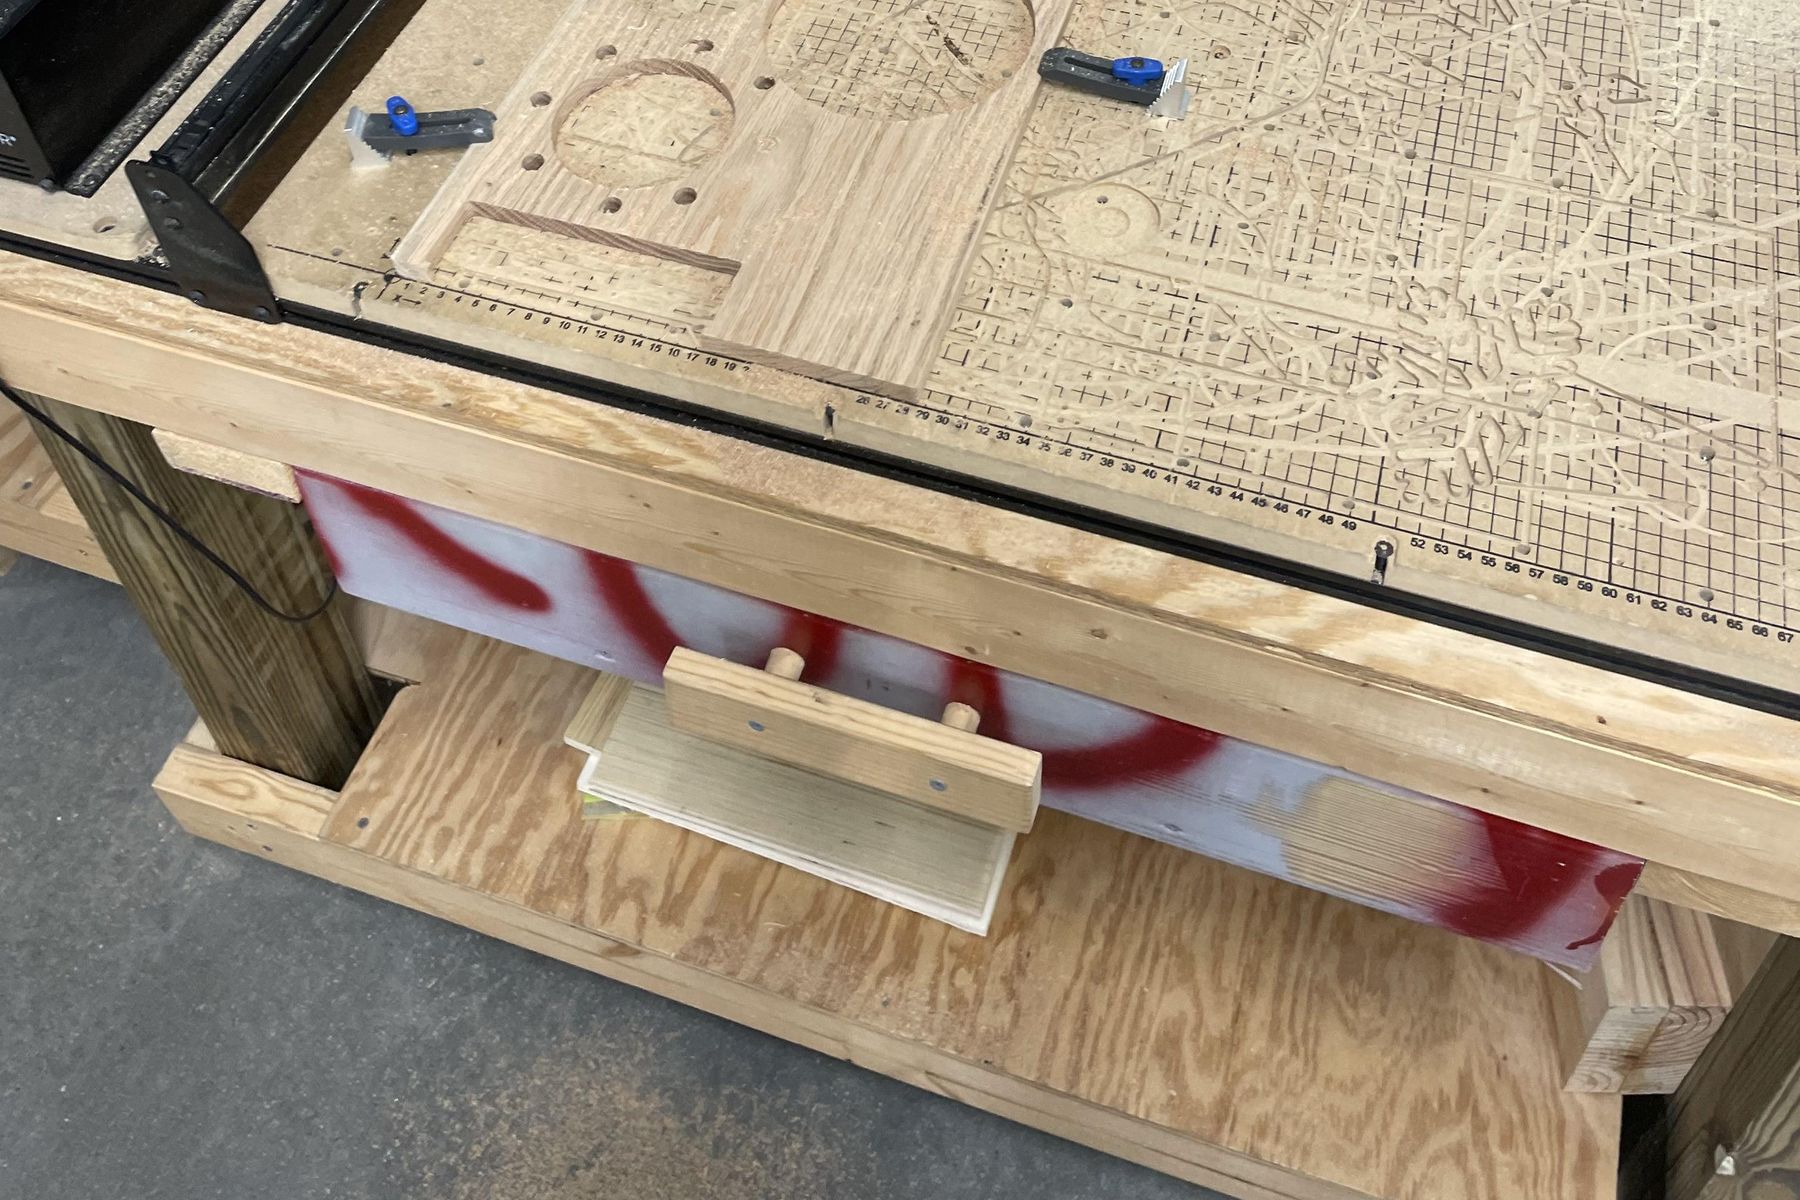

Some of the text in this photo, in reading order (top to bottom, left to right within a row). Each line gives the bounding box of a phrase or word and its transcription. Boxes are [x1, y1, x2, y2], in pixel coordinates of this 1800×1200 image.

[419, 286, 428, 295] 2
[436, 291, 445, 299] 3
[489, 303, 498, 312] 6
[507, 308, 516, 316] 7
[524, 312, 532, 321] 8
[542, 316, 551, 325] 9
[559, 320, 571, 330] 10
[577, 325, 588, 335] 11
[595, 329, 607, 339] 12
[613, 334, 626, 344] 13
[631, 338, 643, 348] 14
[649, 343, 662, 353] 15
[686, 352, 700, 362] 17
[705, 356, 718, 367] 18
[724, 361, 737, 371] 19
[935, 414, 950, 425] 30
[975, 424, 990, 436] 32
[995, 430, 1010, 441] 33
[1016, 435, 1030, 446] 34
[1079, 451, 1094, 462] 37
[1100, 456, 1115, 468] 38
[1121, 462, 1136, 473] 39
[1142, 468, 1157, 479] 40
[1163, 473, 1178, 485] 41
[1185, 479, 1200, 490] 42
[1206, 485, 1222, 496] 43
[1229, 491, 1244, 502] 44
[1251, 496, 1267, 508] 45
[1273, 502, 1289, 514] 46
[1295, 508, 1312, 519] 47
[1318, 514, 1334, 525] 48
[1341, 519, 1357, 531] 49
[1410, 537, 1426, 549] 52
[1433, 543, 1449, 555] 53
[1457, 549, 1472, 561] 54
[1481, 555, 1497, 568] 55
[1504, 561, 1520, 573] 56
[1528, 567, 1545, 579] 57
[1552, 573, 1569, 586] 58
[1577, 580, 1593, 592] 59
[1601, 586, 1618, 599] 60
[1626, 593, 1641, 606] 61
[1651, 599, 1667, 611] 62
[1676, 605, 1693, 618] 63
[1701, 612, 1717, 624] 64
[1726, 618, 1743, 631] 65
[1751, 624, 1769, 637] 66
[1777, 631, 1794, 643] 67
